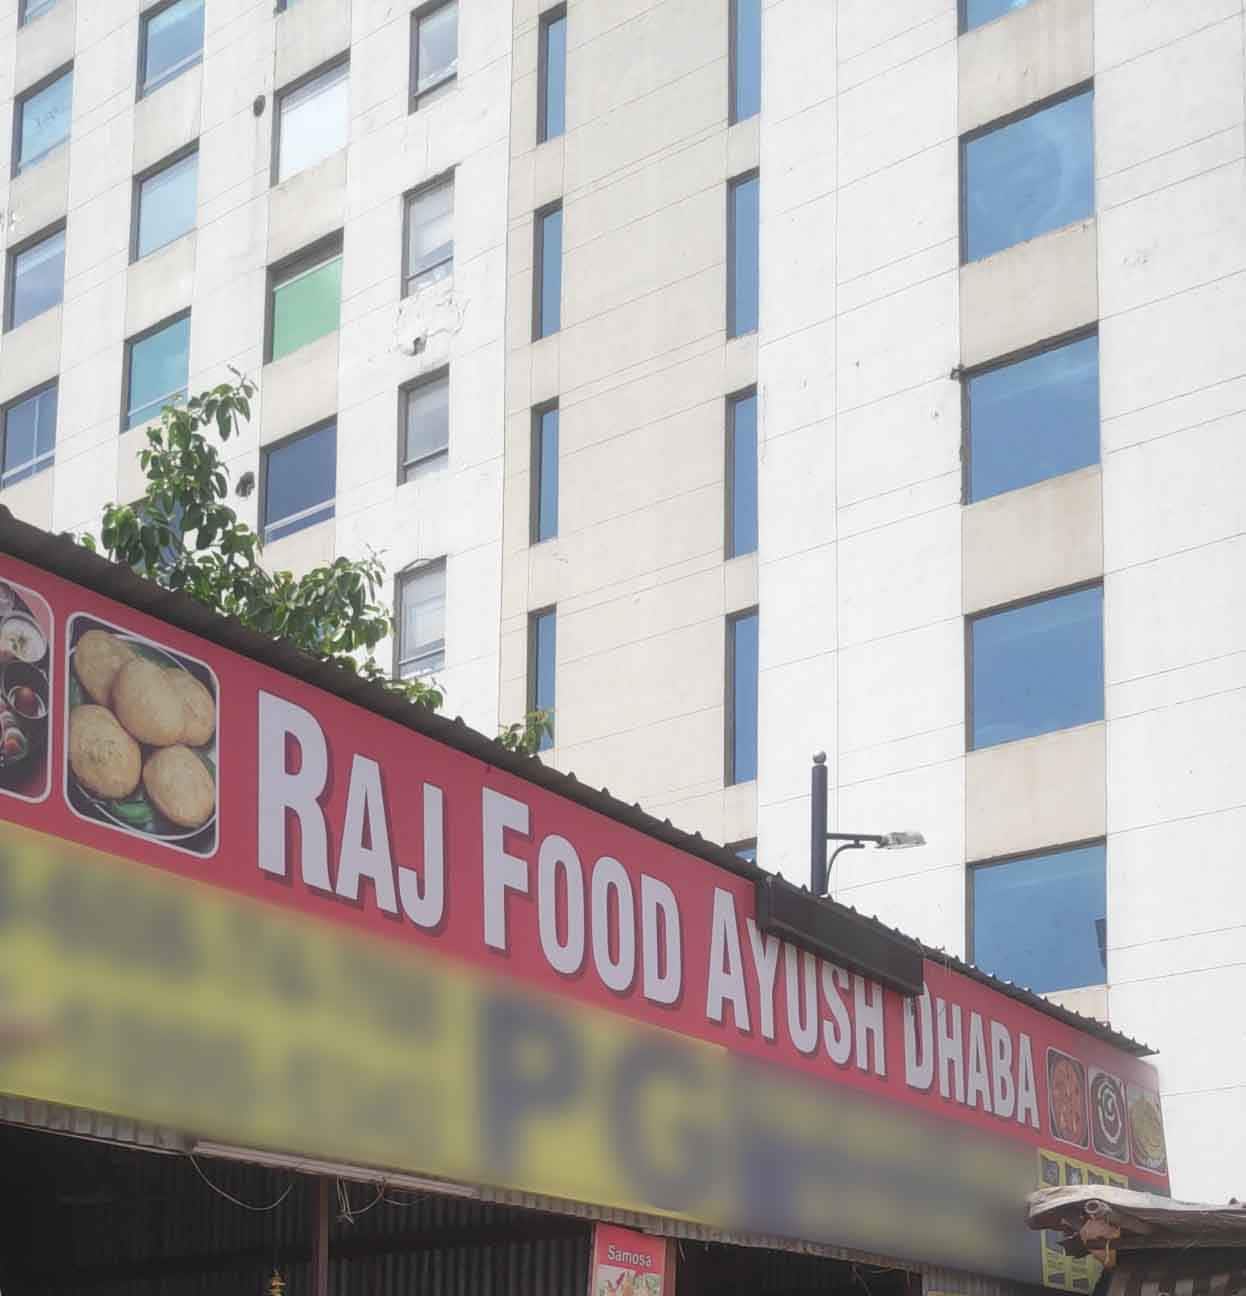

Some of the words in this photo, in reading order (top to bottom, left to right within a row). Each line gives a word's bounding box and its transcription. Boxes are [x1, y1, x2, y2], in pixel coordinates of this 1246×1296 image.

[257, 689, 446, 930] RAJ
[481, 785, 684, 1006] FOOD
[706, 887, 887, 1078] AYUSH
[904, 983, 1041, 1129] DHABA
[607, 1244, 653, 1267] Samosa
